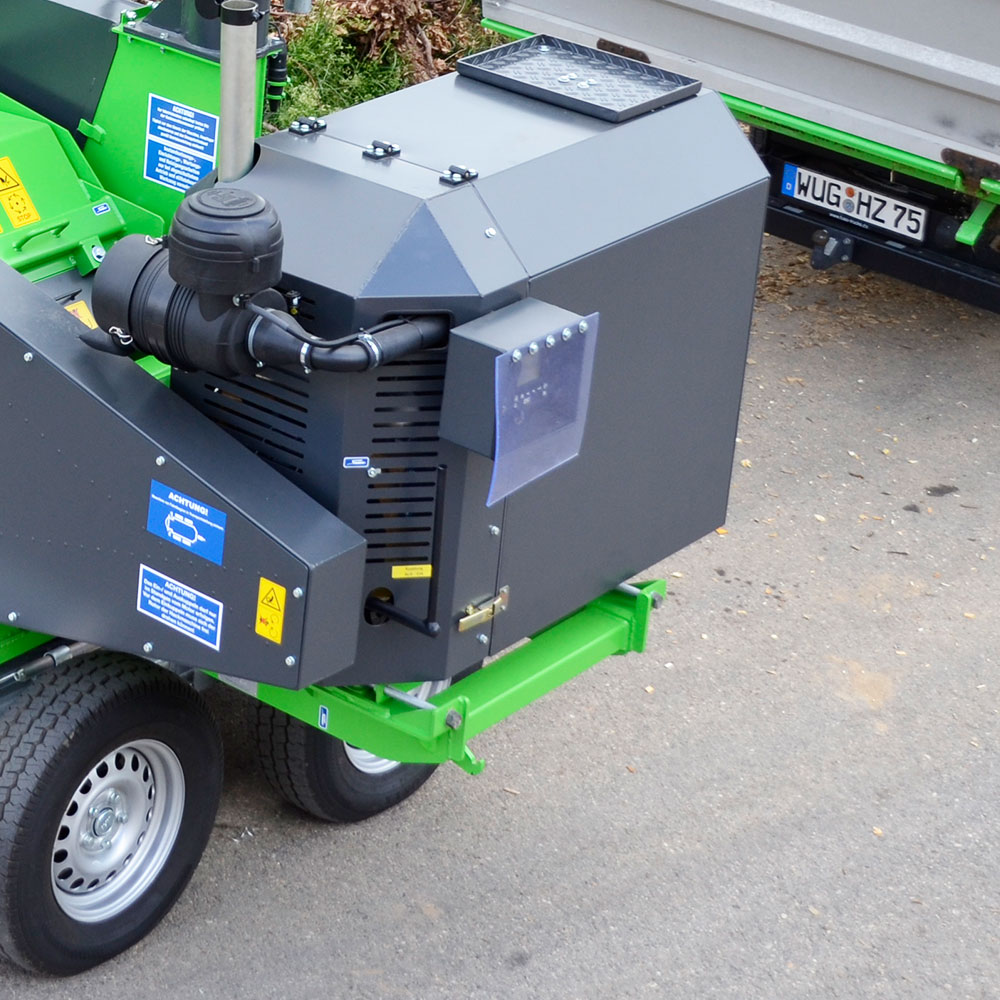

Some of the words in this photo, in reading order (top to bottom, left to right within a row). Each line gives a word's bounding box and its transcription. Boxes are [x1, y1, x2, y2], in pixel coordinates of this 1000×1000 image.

[797, 171, 841, 208] WUG
[856, 191, 888, 225] HZ
[893, 204, 922, 235] 75
[168, 492, 208, 516] ACHTUNG!
